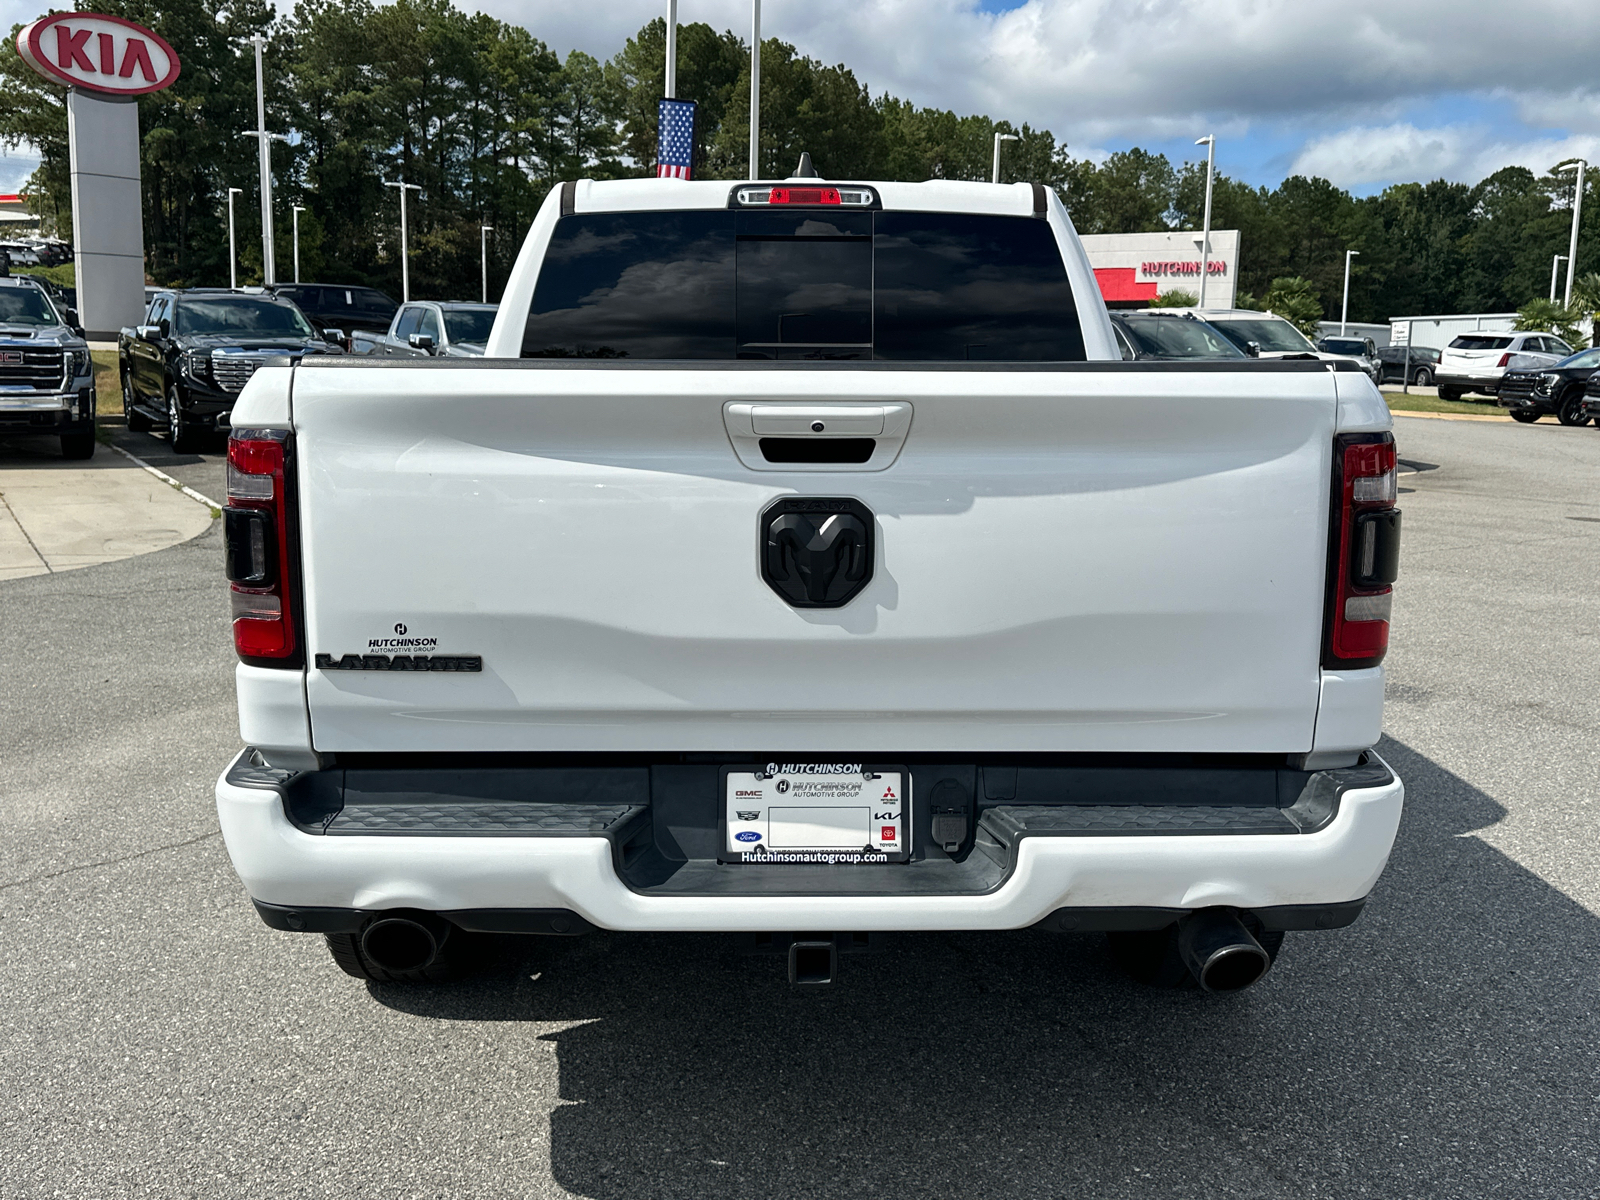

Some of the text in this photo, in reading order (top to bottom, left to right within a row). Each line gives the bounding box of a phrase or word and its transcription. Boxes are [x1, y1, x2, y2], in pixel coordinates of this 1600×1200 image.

[54, 25, 158, 82] KIA
[784, 501, 851, 510] RAM
[368, 638, 437, 647] HUTCHINSON
[315, 653, 482, 672] LARAMIE
[780, 764, 862, 774] HUTCHINSON
[792, 781, 863, 791] HUTCHINSON
[741, 852, 888, 863] Hutchinsonautogroup.com
